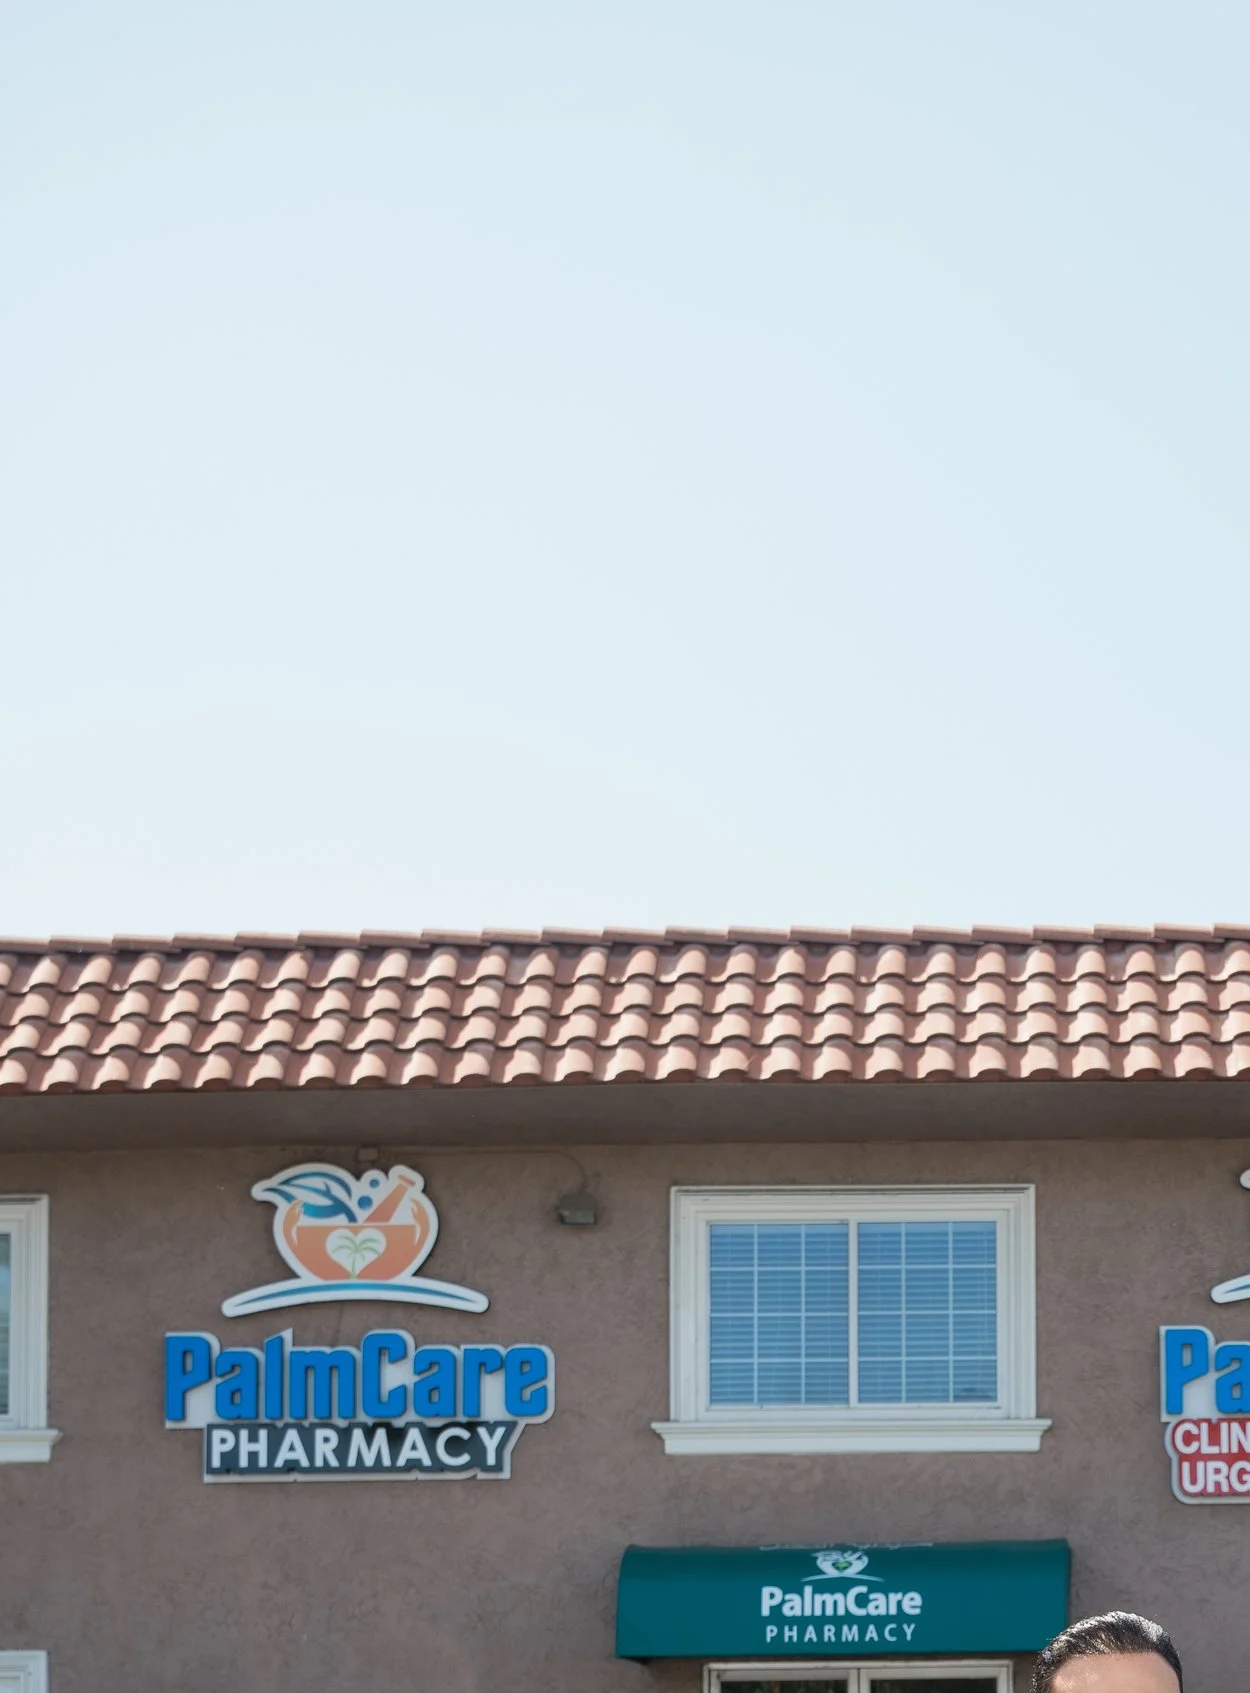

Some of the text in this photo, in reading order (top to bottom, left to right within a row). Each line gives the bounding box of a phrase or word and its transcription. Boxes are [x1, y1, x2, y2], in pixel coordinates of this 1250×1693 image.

[166, 1333, 548, 1421] PalmCare
[211, 1425, 507, 1469] PHARMACY
[760, 1585, 923, 1617] PalmCare
[765, 1623, 916, 1644] PHARMACY
